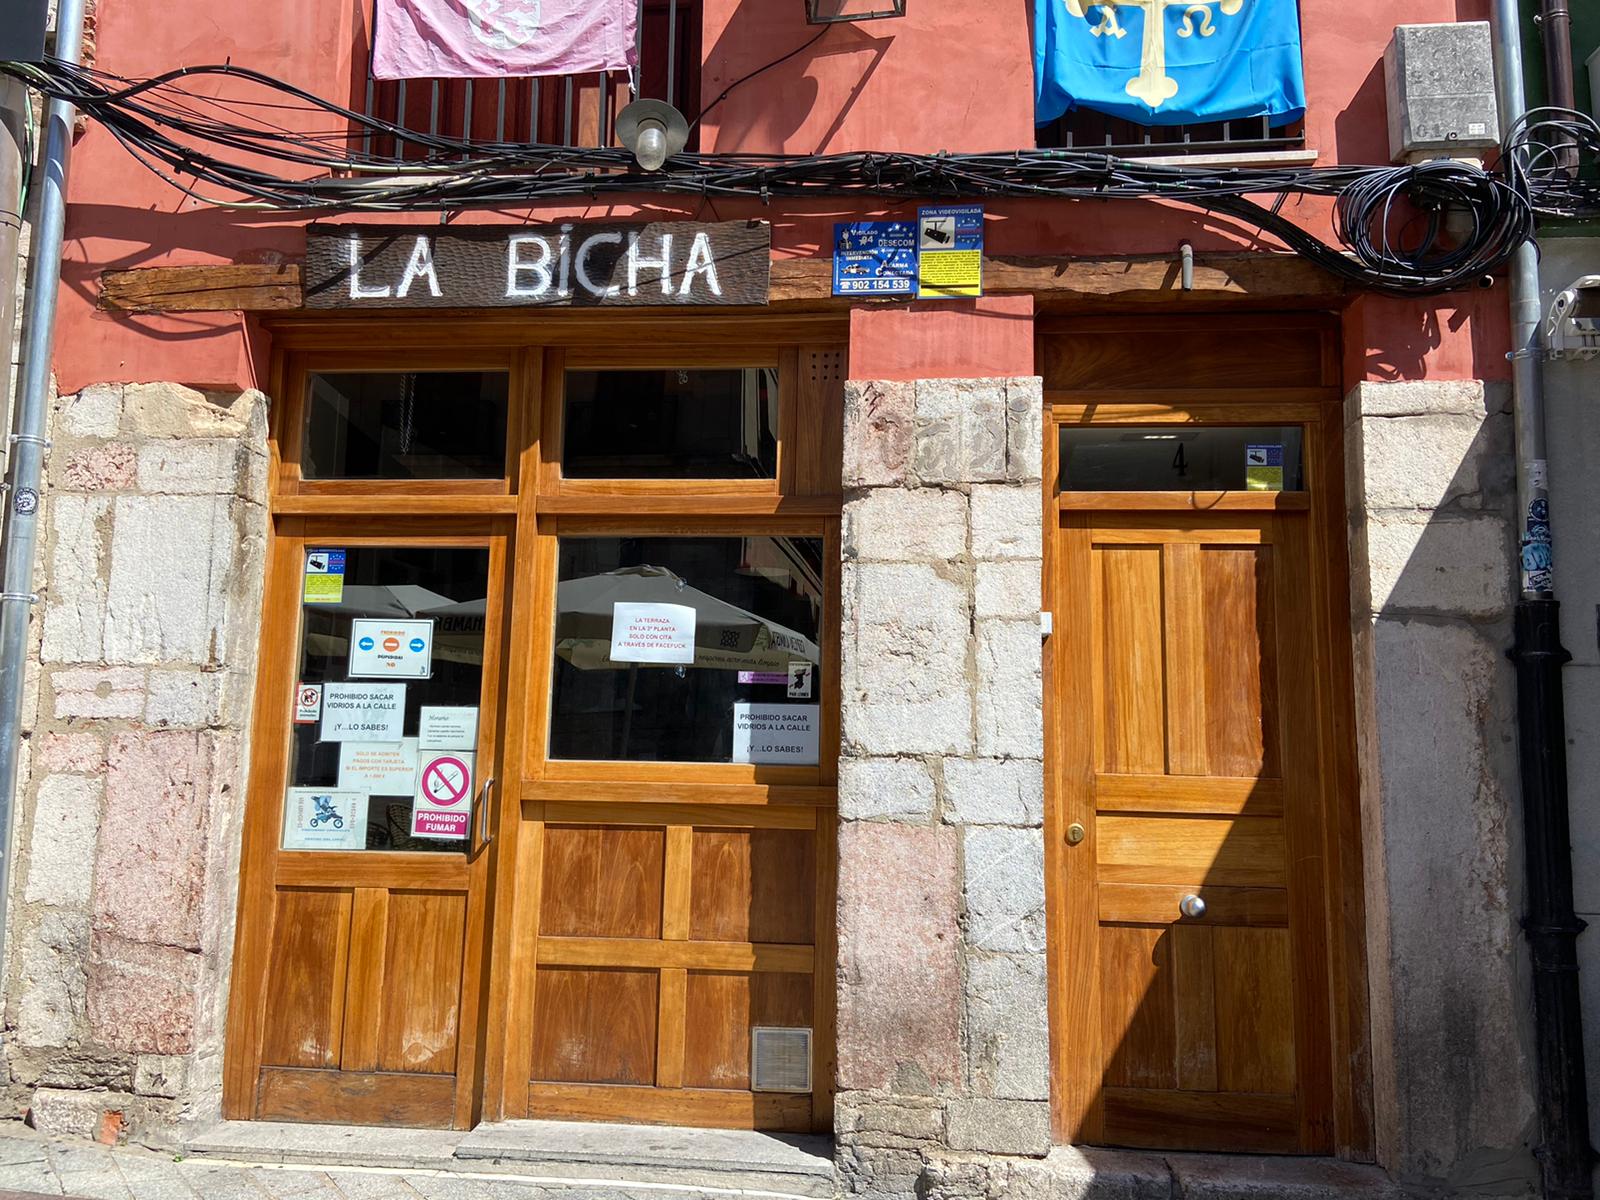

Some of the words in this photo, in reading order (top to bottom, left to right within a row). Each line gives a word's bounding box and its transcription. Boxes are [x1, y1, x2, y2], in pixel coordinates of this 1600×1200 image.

[878, 239, 915, 247] DESECOM
[349, 232, 443, 299] LA
[852, 280, 870, 289] 902
[872, 280, 890, 289] 154
[892, 279, 910, 289] 539
[1173, 442, 1188, 477] 4
[740, 713, 781, 721] PROHIBIDO
[360, 723, 389, 731] SABES!
[417, 812, 466, 823] PROHIBIDO
[425, 823, 456, 832] FUMAR
